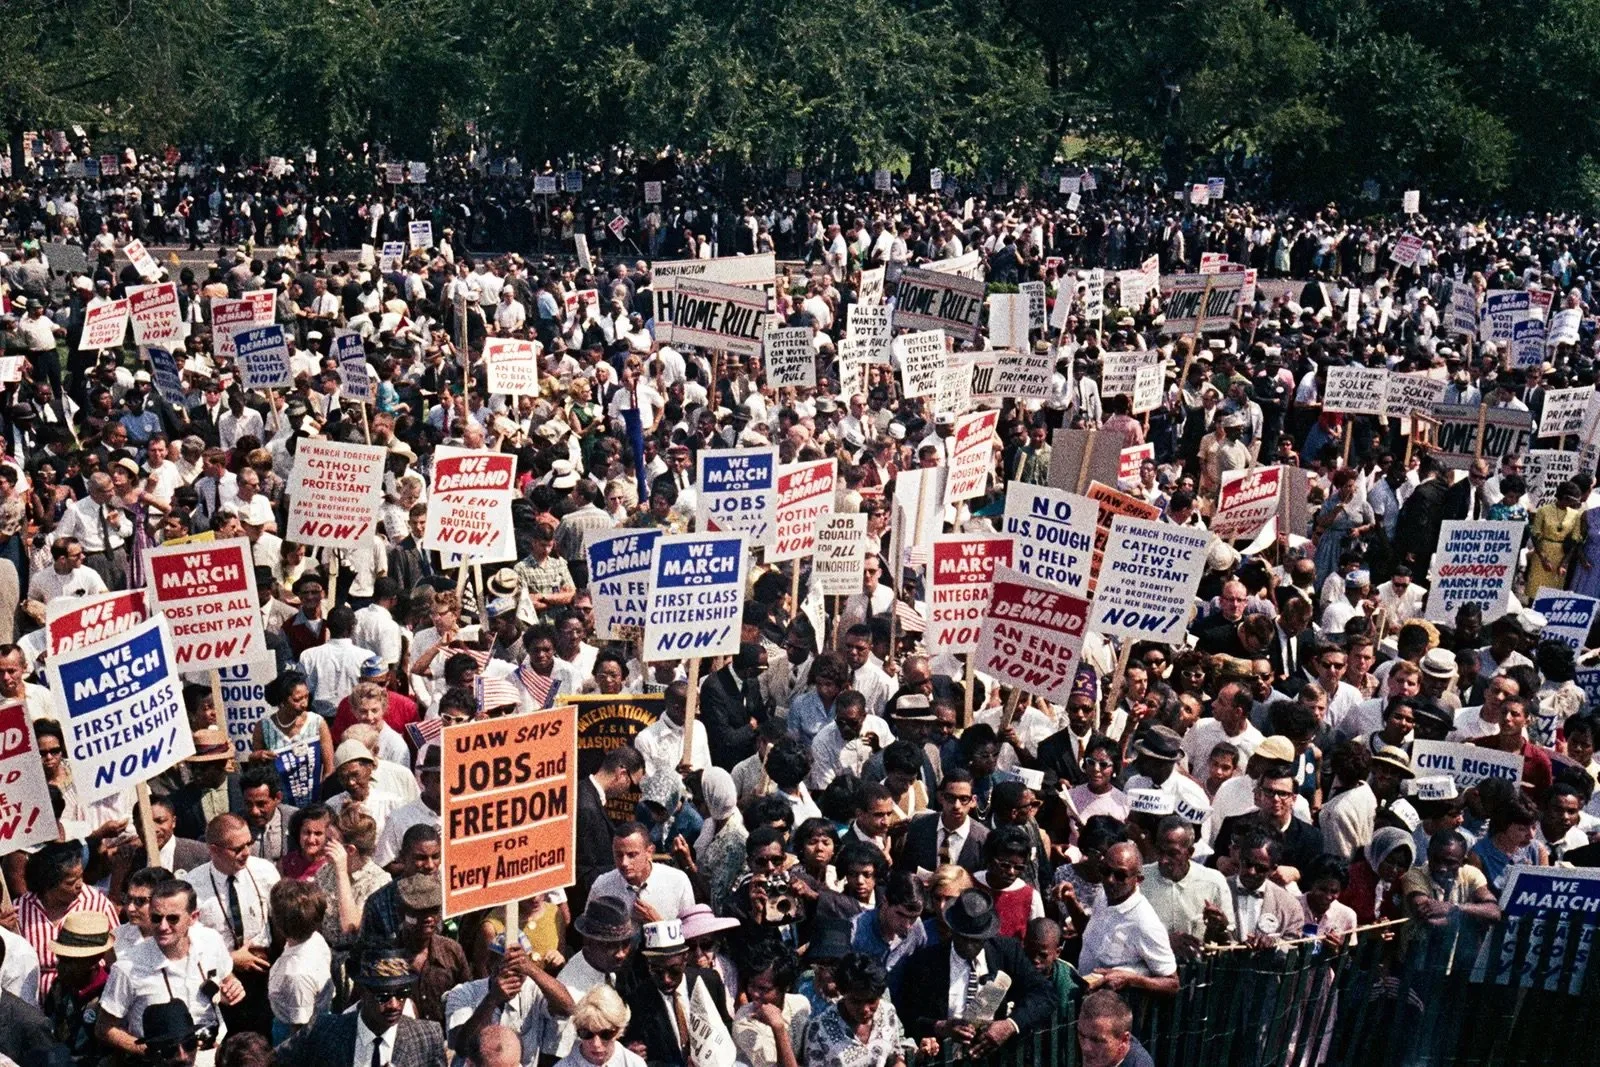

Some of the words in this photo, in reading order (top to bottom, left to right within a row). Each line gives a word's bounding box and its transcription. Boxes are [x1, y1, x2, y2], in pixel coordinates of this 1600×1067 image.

[655, 265, 706, 276] WASHINGTON
[225, 304, 240, 312] WE
[899, 282, 940, 315] HOME
[938, 288, 977, 325] RULE
[1166, 290, 1204, 319] HOME
[1204, 288, 1240, 318] RULE
[153, 311, 176, 319] FEPC
[217, 311, 252, 323] DEMAND
[674, 294, 721, 332] HOME
[721, 300, 766, 340] RULE
[854, 308, 871, 316] ALL
[147, 321, 170, 329] LAW
[852, 318, 876, 326] WANTS
[249, 330, 266, 340] WE
[240, 335, 281, 352] DEMAND
[246, 354, 281, 362] EQUAL
[921, 361, 944, 370] WANTS
[998, 358, 1022, 366] HOME
[1026, 358, 1049, 367] RULE
[247, 363, 285, 371] RIGHTS
[250, 371, 287, 383] NOW!
[781, 372, 805, 383] RULE
[1000, 372, 1048, 383] PRIMARY
[1339, 380, 1374, 390] SOLVE
[994, 383, 1016, 393] CIVIL
[1020, 384, 1048, 395] RIGHT
[1402, 386, 1435, 401] SOLVE
[313, 448, 340, 458] MARCH
[344, 451, 381, 462] TOGETHER
[728, 458, 749, 468] WE
[957, 451, 986, 466] DECENT
[308, 459, 370, 473] CATHOLIC
[460, 457, 488, 472] WE
[951, 465, 986, 480] HOUSING
[319, 471, 356, 481] JEWS
[439, 470, 508, 490] DEMAND
[708, 467, 767, 483] MARCH
[790, 468, 815, 486] WE
[1240, 472, 1264, 490] WE
[302, 479, 371, 494] PROTESTANT
[951, 476, 982, 494] NOW!
[441, 494, 464, 503] AN
[468, 496, 499, 507] END
[709, 495, 766, 512] JOBS
[1224, 483, 1277, 509] DEMAND
[776, 505, 829, 522] VOTING
[1031, 496, 1072, 521] NO
[1094, 490, 1123, 511] UAW
[1124, 502, 1152, 521] SAYS
[1225, 507, 1269, 520] DECENT
[451, 508, 486, 521] POLICE
[300, 521, 368, 540] NOW!
[440, 516, 492, 530] BRUTALITY
[827, 519, 854, 529] JOB
[437, 528, 499, 547] NOW!
[819, 531, 862, 540] EQUALITY
[1036, 523, 1091, 552] DOUGH
[1115, 524, 1128, 534] WE
[1129, 526, 1159, 540] MARCH
[1162, 532, 1207, 549] TOGETHER
[1450, 530, 1511, 541] INDUSTRIAL
[611, 537, 639, 556] WE
[688, 544, 713, 557] WE
[831, 545, 856, 558] ALL
[961, 544, 986, 555] WE
[1121, 538, 1192, 561] CATHOLIC
[1445, 543, 1481, 553] UNION
[1483, 543, 1512, 553] DEPT.
[184, 554, 212, 568] WE
[664, 556, 734, 576] MARCH
[1038, 548, 1078, 568] HELP
[1131, 552, 1174, 569] JEWS
[1452, 554, 1499, 564] AFL-CIO
[816, 561, 860, 572] MINORITIES
[1112, 560, 1189, 583] PROTESTANT
[1438, 565, 1508, 577] SUPPORTS
[162, 565, 238, 588] MARCH
[684, 575, 712, 584] FOR
[959, 573, 986, 582] FOR
[1035, 566, 1083, 587] CROW
[1438, 579, 1479, 588] MARCH
[1482, 579, 1503, 588] FOR
[188, 585, 218, 595] FOR
[599, 583, 622, 595] AN
[1120, 578, 1137, 587] FOR
[1140, 580, 1175, 593] DIGNITY
[655, 593, 693, 608] FIRST
[698, 590, 737, 605] CLASS
[1023, 588, 1056, 607] WE
[1103, 585, 1121, 594] AND
[1125, 589, 1185, 605] BROTHERHOOD
[1444, 590, 1499, 600] FREEDOM
[162, 606, 193, 619] OBS
[197, 602, 223, 615] FOR
[228, 598, 252, 611] ALL
[1109, 595, 1122, 605] ALL
[1125, 598, 1140, 607] MEN
[1143, 600, 1167, 612] UNDER
[1445, 602, 1454, 612] &
[1552, 600, 1574, 610] WE
[81, 600, 115, 627] WE
[650, 606, 738, 625] CITIZENSHIP
[994, 601, 1082, 631] DEMAND
[1101, 607, 1180, 633] NOW!
[174, 621, 223, 636] DECENT
[228, 616, 252, 629] PAY
[657, 625, 731, 651] NOW!
[994, 622, 1022, 642] AN
[1029, 633, 1073, 661] END
[176, 633, 251, 663] NOW!
[100, 645, 131, 669] WE
[992, 637, 1014, 656] TO
[1021, 648, 1067, 677] BIAS
[75, 650, 160, 701] MARCH
[988, 654, 1064, 693] NOW!
[107, 683, 141, 702] FOR
[222, 685, 264, 701] DOUG
[74, 711, 123, 740] FIRST
[131, 684, 173, 718] CLASS
[228, 707, 265, 720] HELP
[74, 703, 179, 761] CITIZENSHIP
[455, 730, 509, 753] UAW
[514, 720, 562, 744] SAYS
[94, 728, 176, 788] NOW!
[449, 752, 532, 795] JOBS
[535, 751, 567, 780] and
[1417, 754, 1455, 770] CIVIL
[1462, 758, 1518, 782] RIGHTS
[450, 785, 568, 840] FREEDOM
[1177, 800, 1206, 821] UAW
[493, 836, 528, 853] FOR
[450, 865, 490, 890] Every
[495, 847, 566, 880] American
[1552, 880, 1580, 893] WE
[1516, 891, 1599, 912] MARCH
